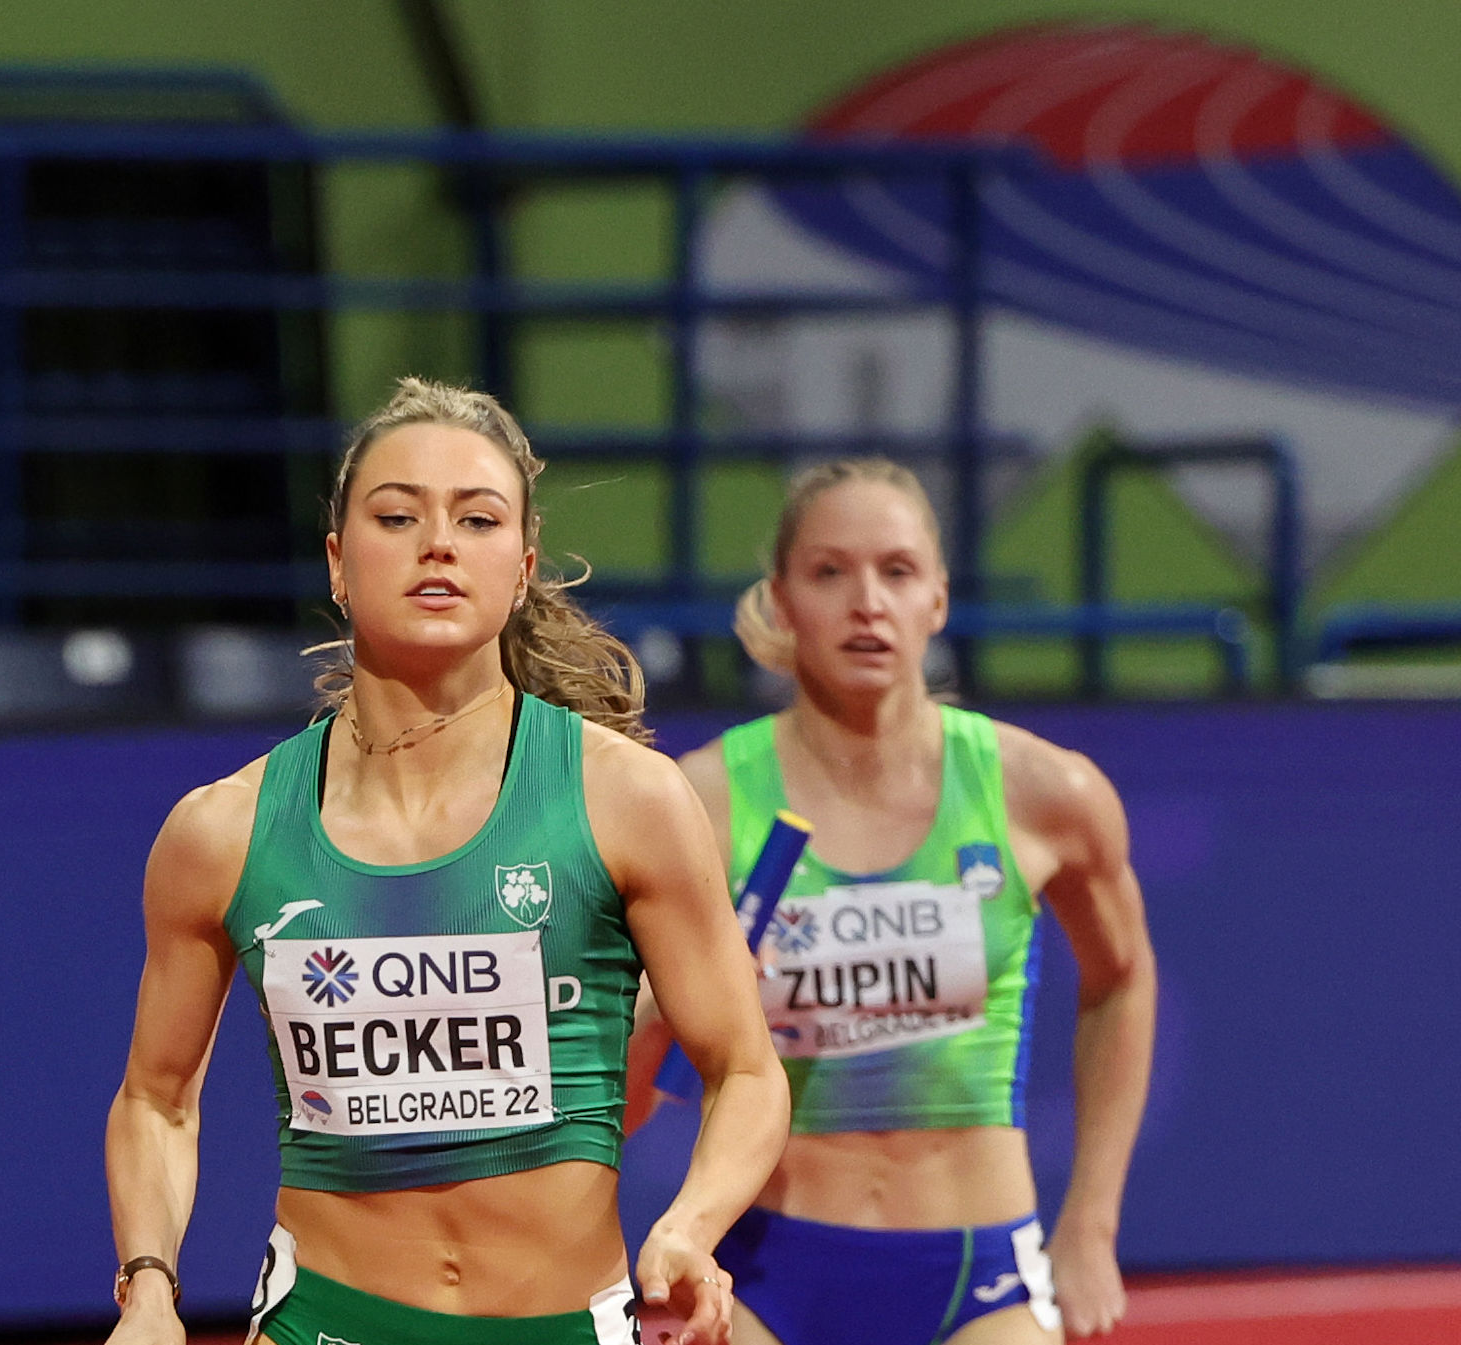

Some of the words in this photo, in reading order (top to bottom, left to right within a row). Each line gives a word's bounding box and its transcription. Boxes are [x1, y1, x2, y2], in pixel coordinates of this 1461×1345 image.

[832, 899, 944, 944] QNB
[372, 949, 502, 998] QNB
[781, 955, 938, 1012] ZUPIN
[288, 1014, 525, 1078] BECKER
[347, 1088, 496, 1125] BELGRADE
[503, 1084, 540, 1117] 22
